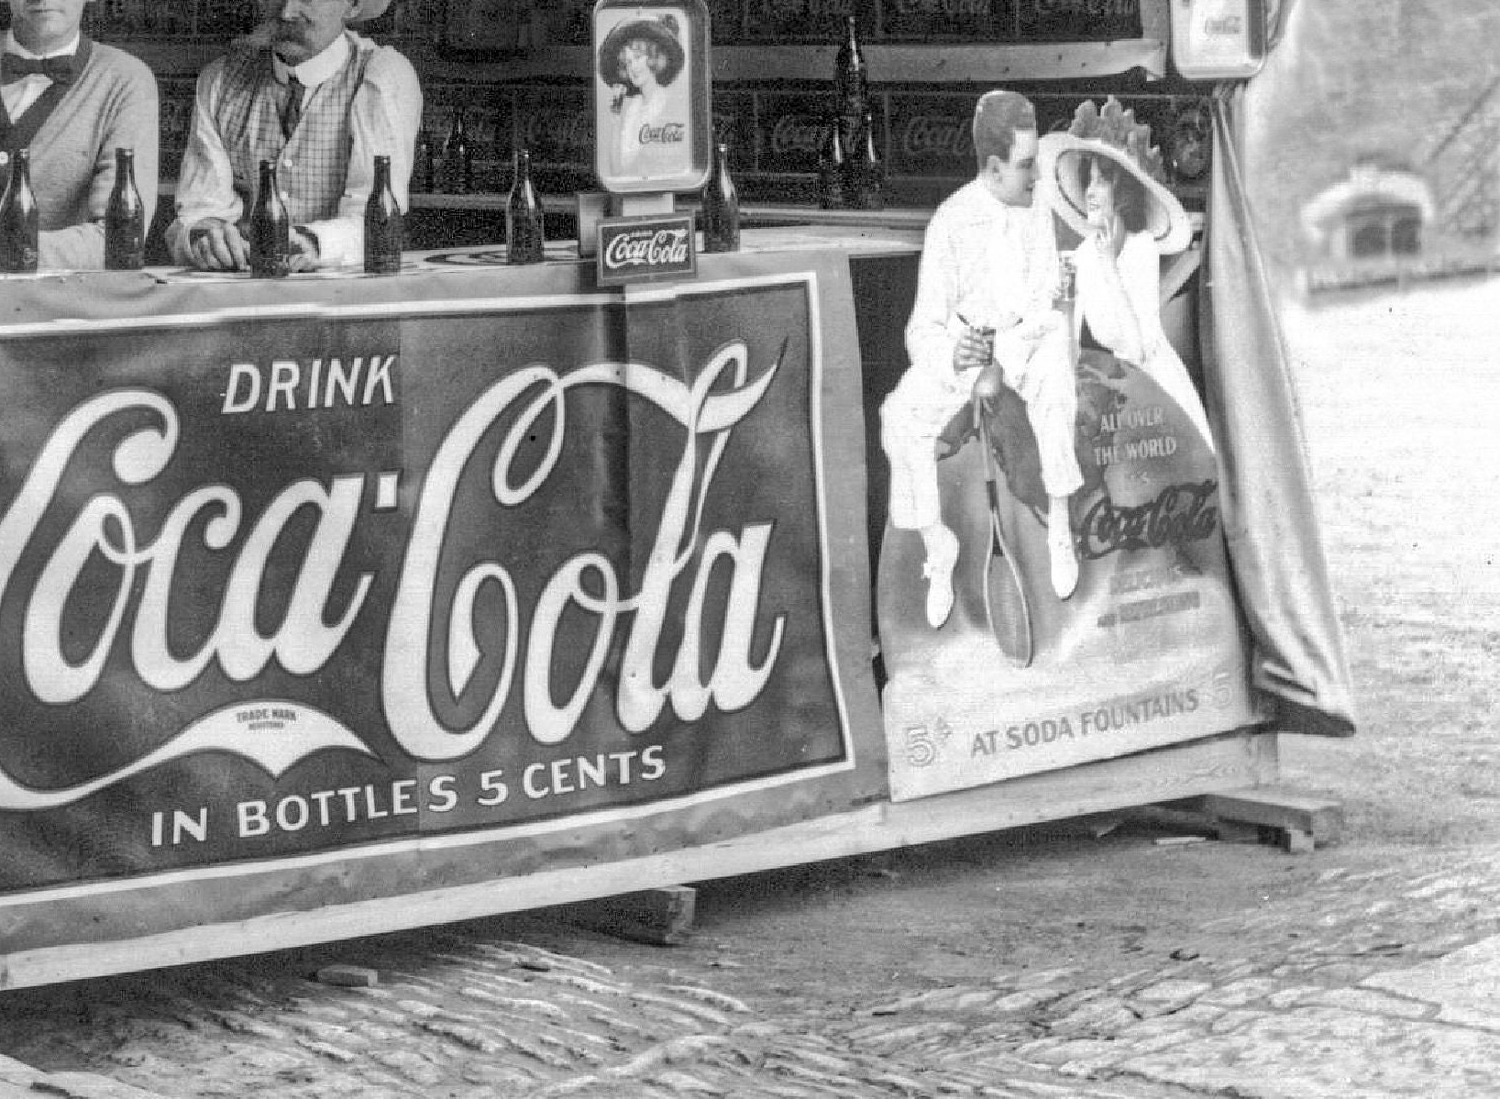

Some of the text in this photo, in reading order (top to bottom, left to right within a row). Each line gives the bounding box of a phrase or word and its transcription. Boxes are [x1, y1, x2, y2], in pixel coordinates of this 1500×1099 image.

[221, 353, 399, 415] DRINK
[1125, 435, 1178, 460] WORLD
[236, 708, 298, 724] TRADE MARK
[971, 688, 1200, 758] AT SODA FOUNTAINS
[150, 744, 668, 849] IN BOTTLES 5 CENTS
